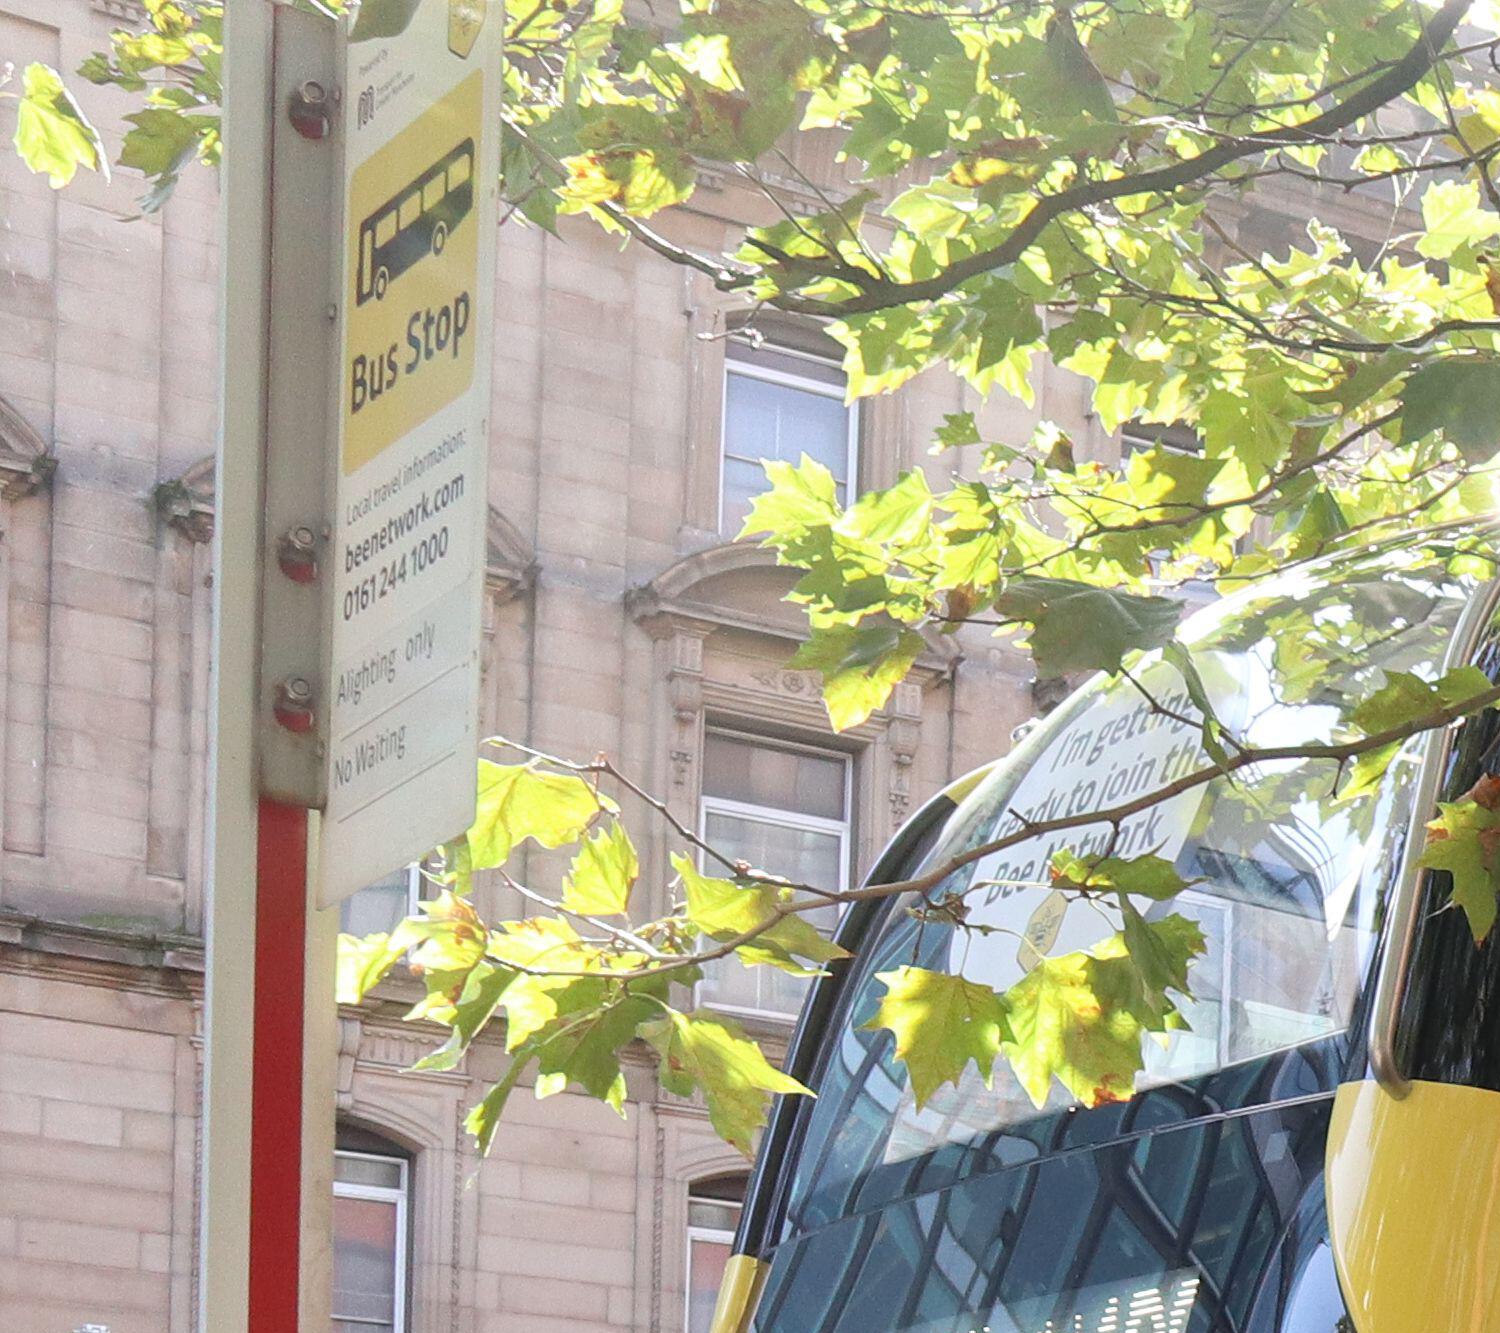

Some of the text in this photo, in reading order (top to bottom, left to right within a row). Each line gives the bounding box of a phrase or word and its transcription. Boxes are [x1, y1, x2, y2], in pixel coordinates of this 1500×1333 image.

[351, 291, 470, 415] Bus Stop
[345, 473, 465, 574] beenetwork.com
[346, 428, 467, 526] Local travel information:
[343, 526, 449, 621] 0161 244 1000
[337, 620, 436, 706] Alighting only
[334, 725, 406, 789] No Waiting
[1065, 778, 1096, 816] to
